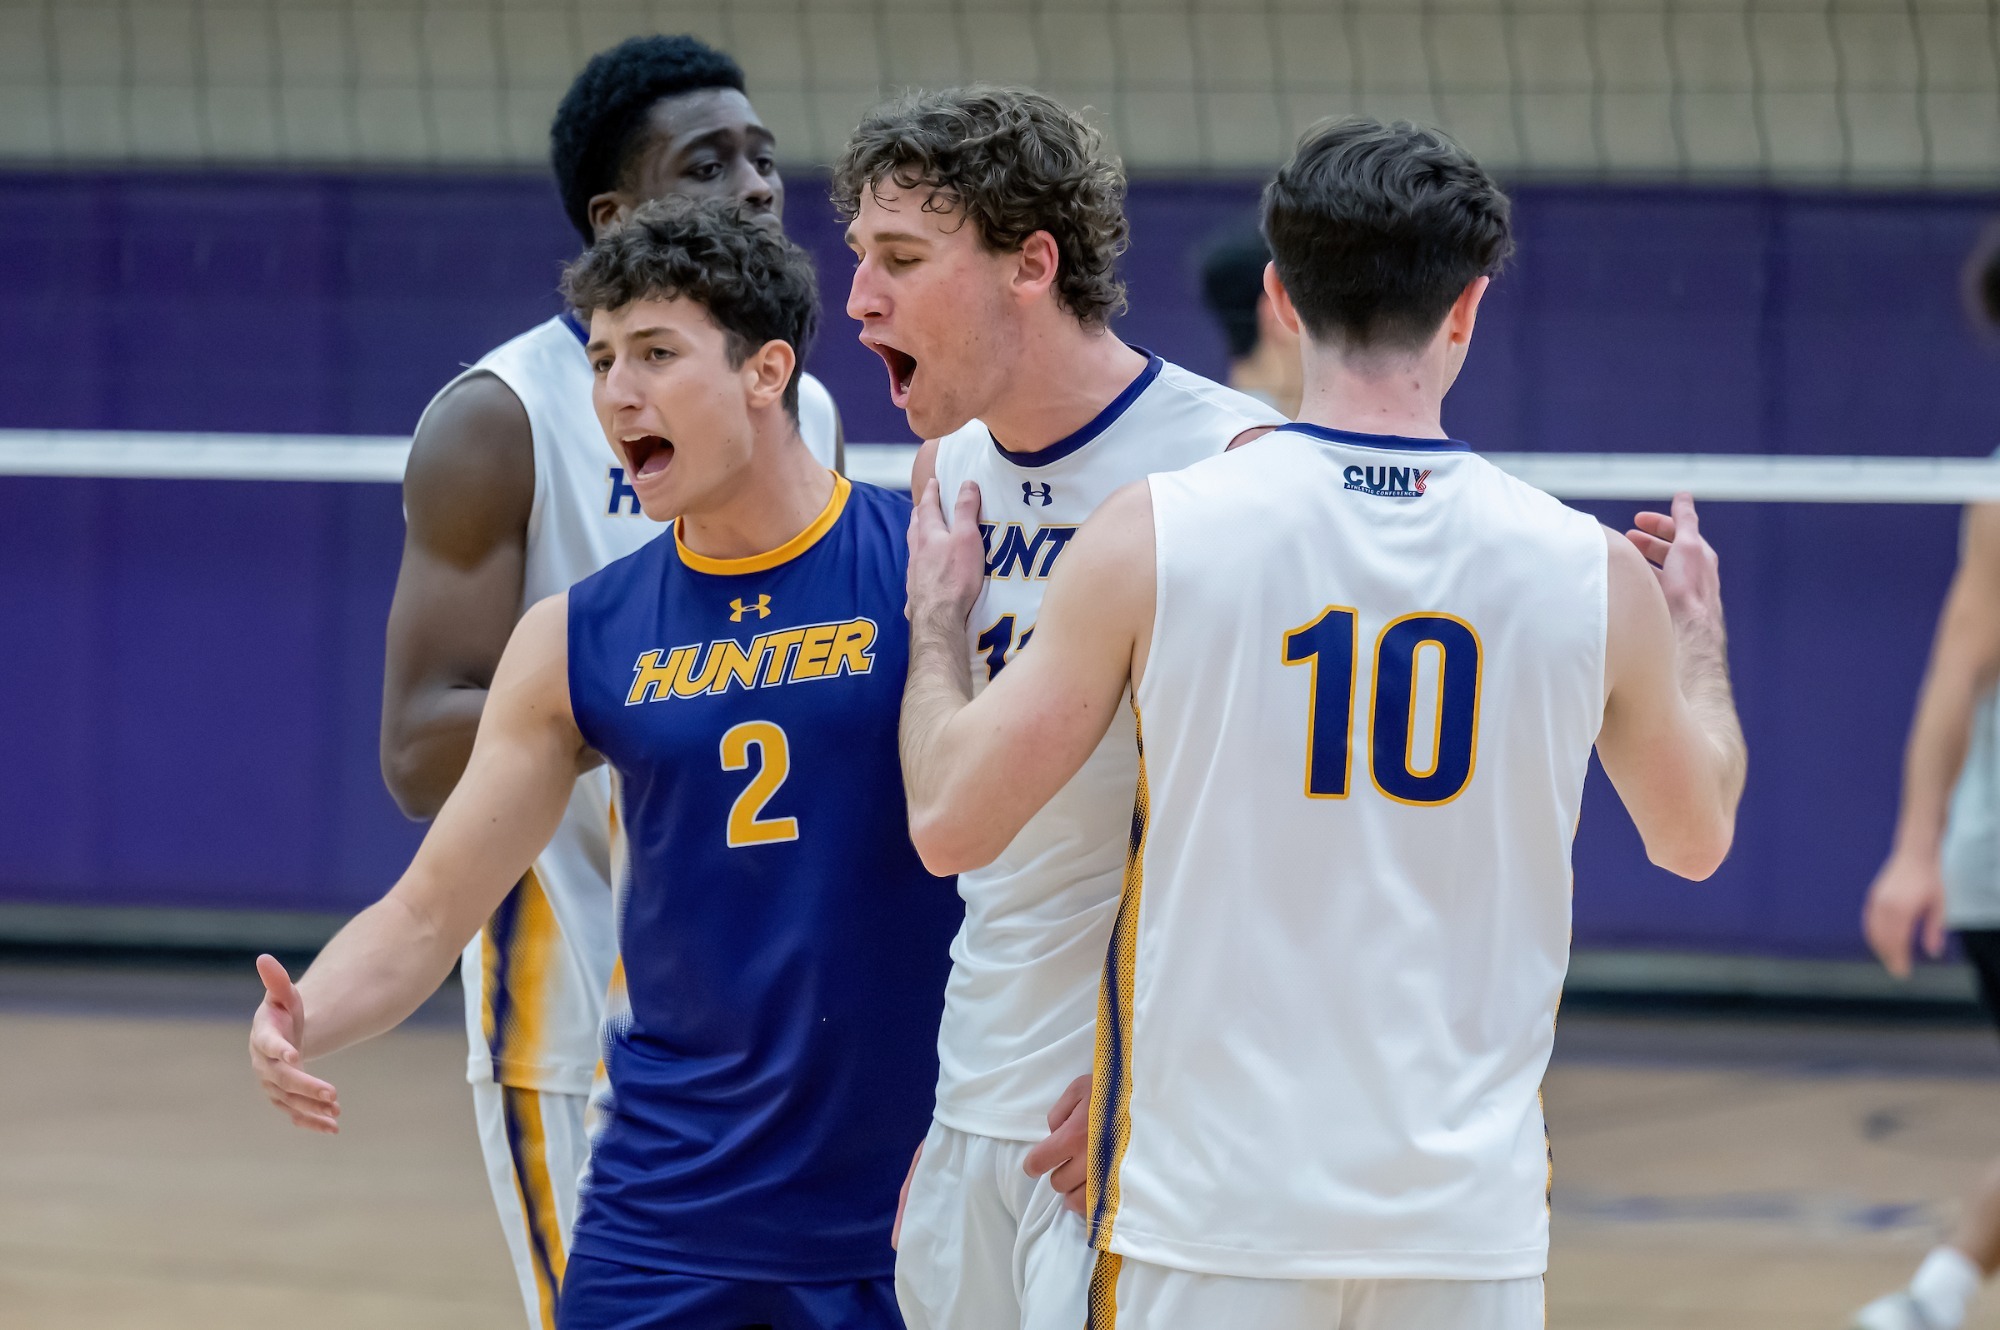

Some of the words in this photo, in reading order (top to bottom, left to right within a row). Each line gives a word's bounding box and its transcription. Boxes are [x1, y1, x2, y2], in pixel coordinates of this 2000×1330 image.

[1343, 465, 1432, 493] CUNY
[1346, 485, 1374, 494] ATHLETIC
[979, 521, 1081, 581] UNT
[625, 617, 878, 706] HUNTER
[977, 613, 1036, 682] 1
[1281, 604, 1483, 807] 10
[719, 719, 799, 848] 2
